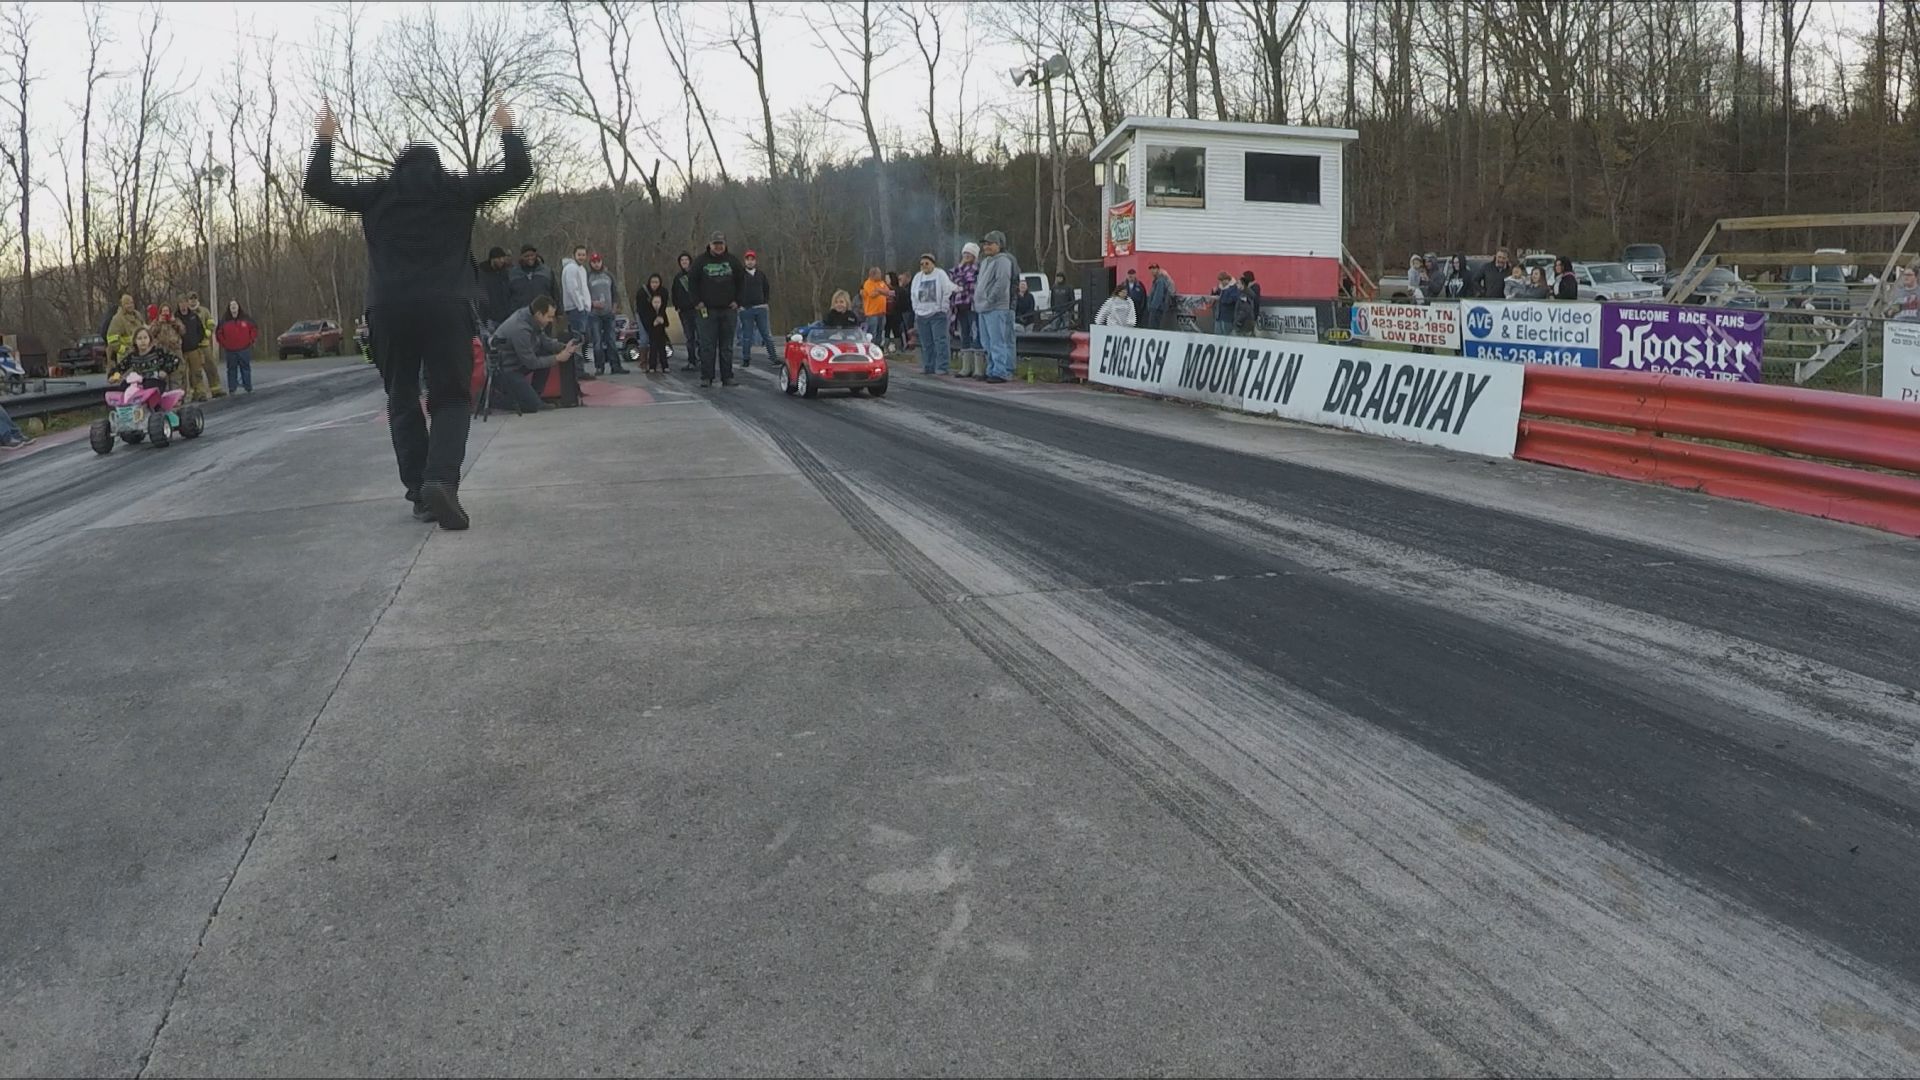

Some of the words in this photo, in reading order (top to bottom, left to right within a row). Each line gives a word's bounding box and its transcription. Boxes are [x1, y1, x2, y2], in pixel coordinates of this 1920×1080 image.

[1371, 306, 1432, 321] NEWPORT,
[1436, 310, 1456, 321] TN.
[1467, 312, 1493, 329] AVE
[1501, 307, 1542, 322] Audio
[1548, 308, 1592, 324] Video
[1619, 308, 1669, 322] WELCOME
[1678, 312, 1707, 325] RACE
[1716, 314, 1745, 328] FANS
[1371, 318, 1455, 334] 423-623-1850
[1501, 325, 1510, 339] &
[1516, 325, 1589, 343] Electrical
[1382, 331, 1406, 341] LOW
[1409, 333, 1446, 345] RATES
[1610, 322, 1752, 372] Hoosier
[1477, 346, 1582, 367] 865-258-8184
[1650, 364, 1706, 380] RACING
[1711, 371, 1742, 382] TIRE
[1099, 335, 1170, 383] ENGLISH
[1178, 342, 1304, 405] MOUNTAIN
[1322, 358, 1492, 435] DRAGWAY
